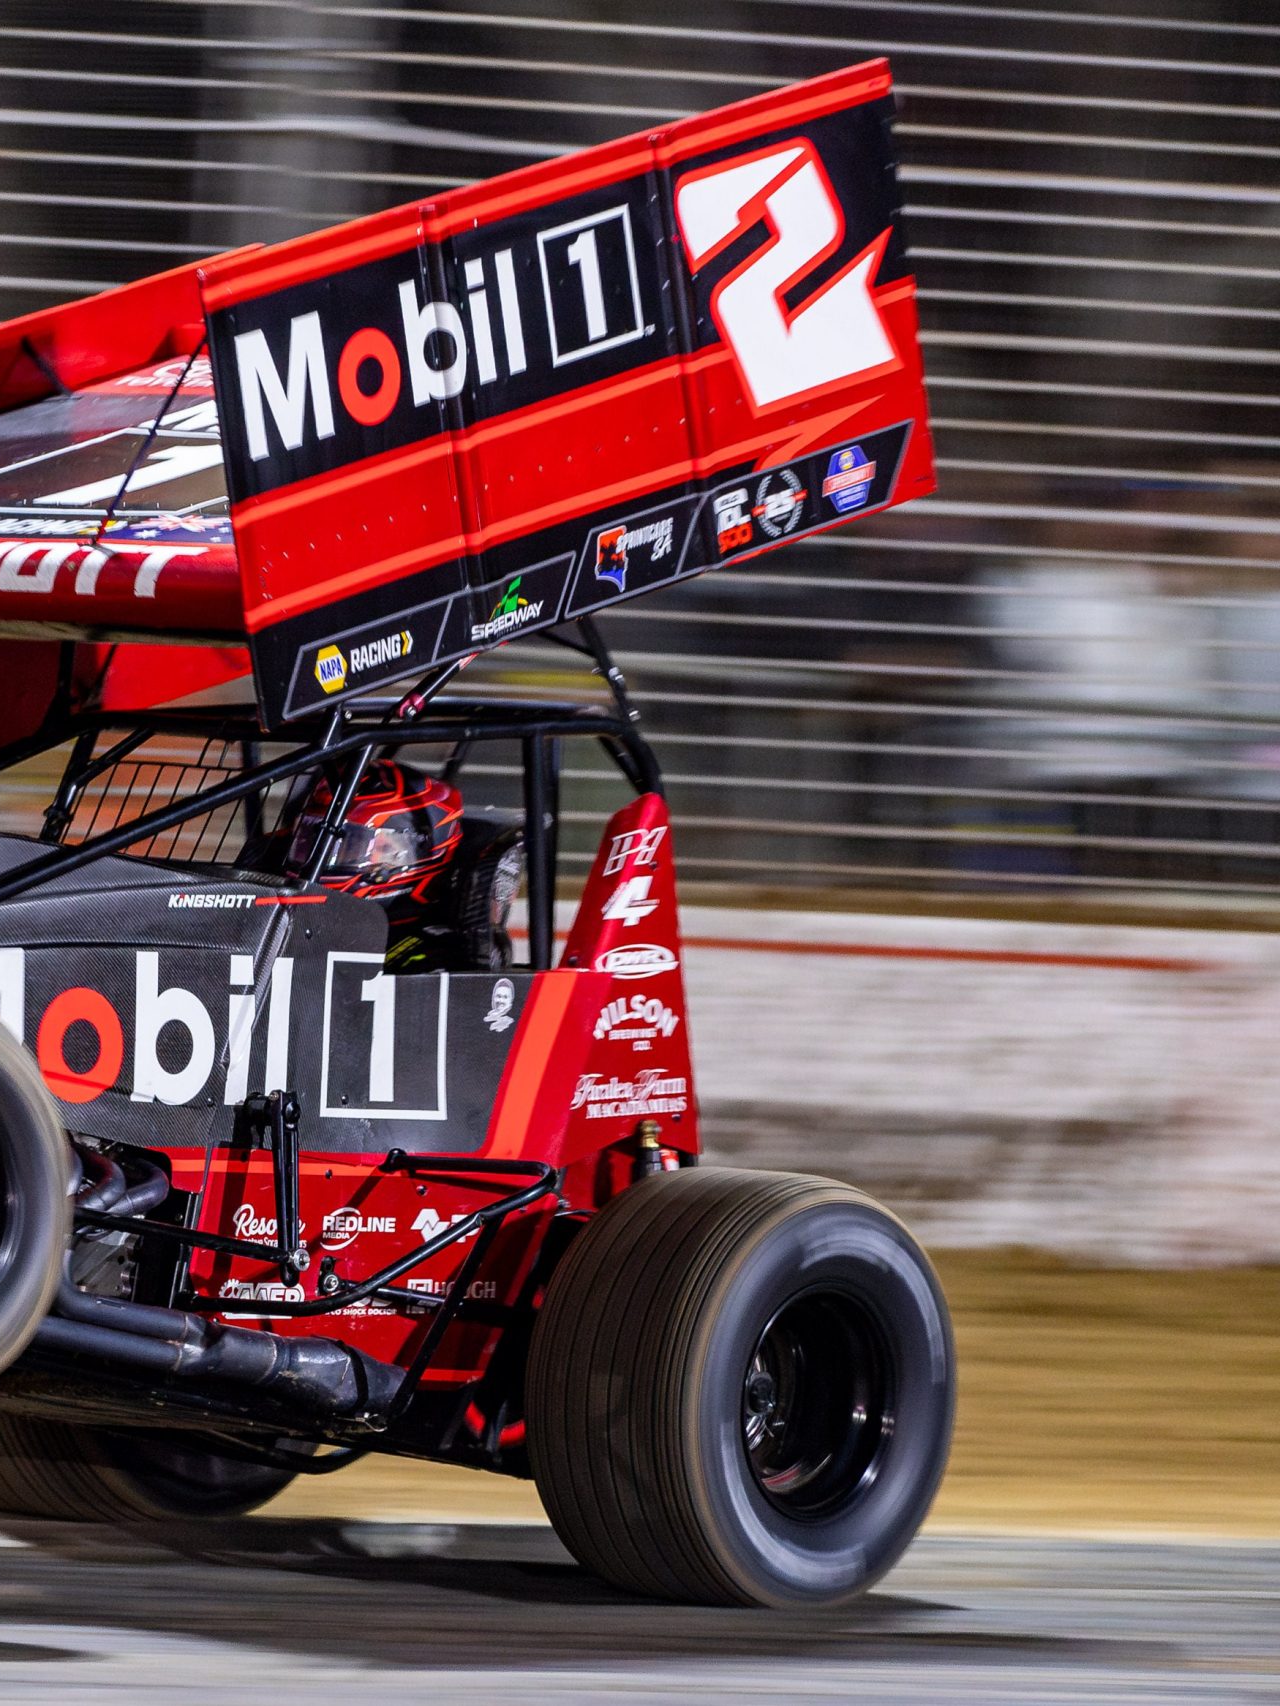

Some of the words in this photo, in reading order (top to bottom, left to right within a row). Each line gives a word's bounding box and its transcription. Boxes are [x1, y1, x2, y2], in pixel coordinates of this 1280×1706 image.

[676, 143, 901, 410] 2
[234, 248, 527, 461] Mobil
[567, 229, 610, 342] 1
[471, 600, 544, 642] SPEEDWAY
[319, 656, 344, 682] NAPA
[350, 632, 402, 674] RACING
[360, 971, 395, 1103] 1
[592, 994, 680, 1040] WILSON
[322, 1215, 396, 1233] REDLINE
[322, 1231, 350, 1239] MEDIA
[342, 1308, 367, 1316] SHOCK
[367, 1308, 397, 1316] DOCTOR
